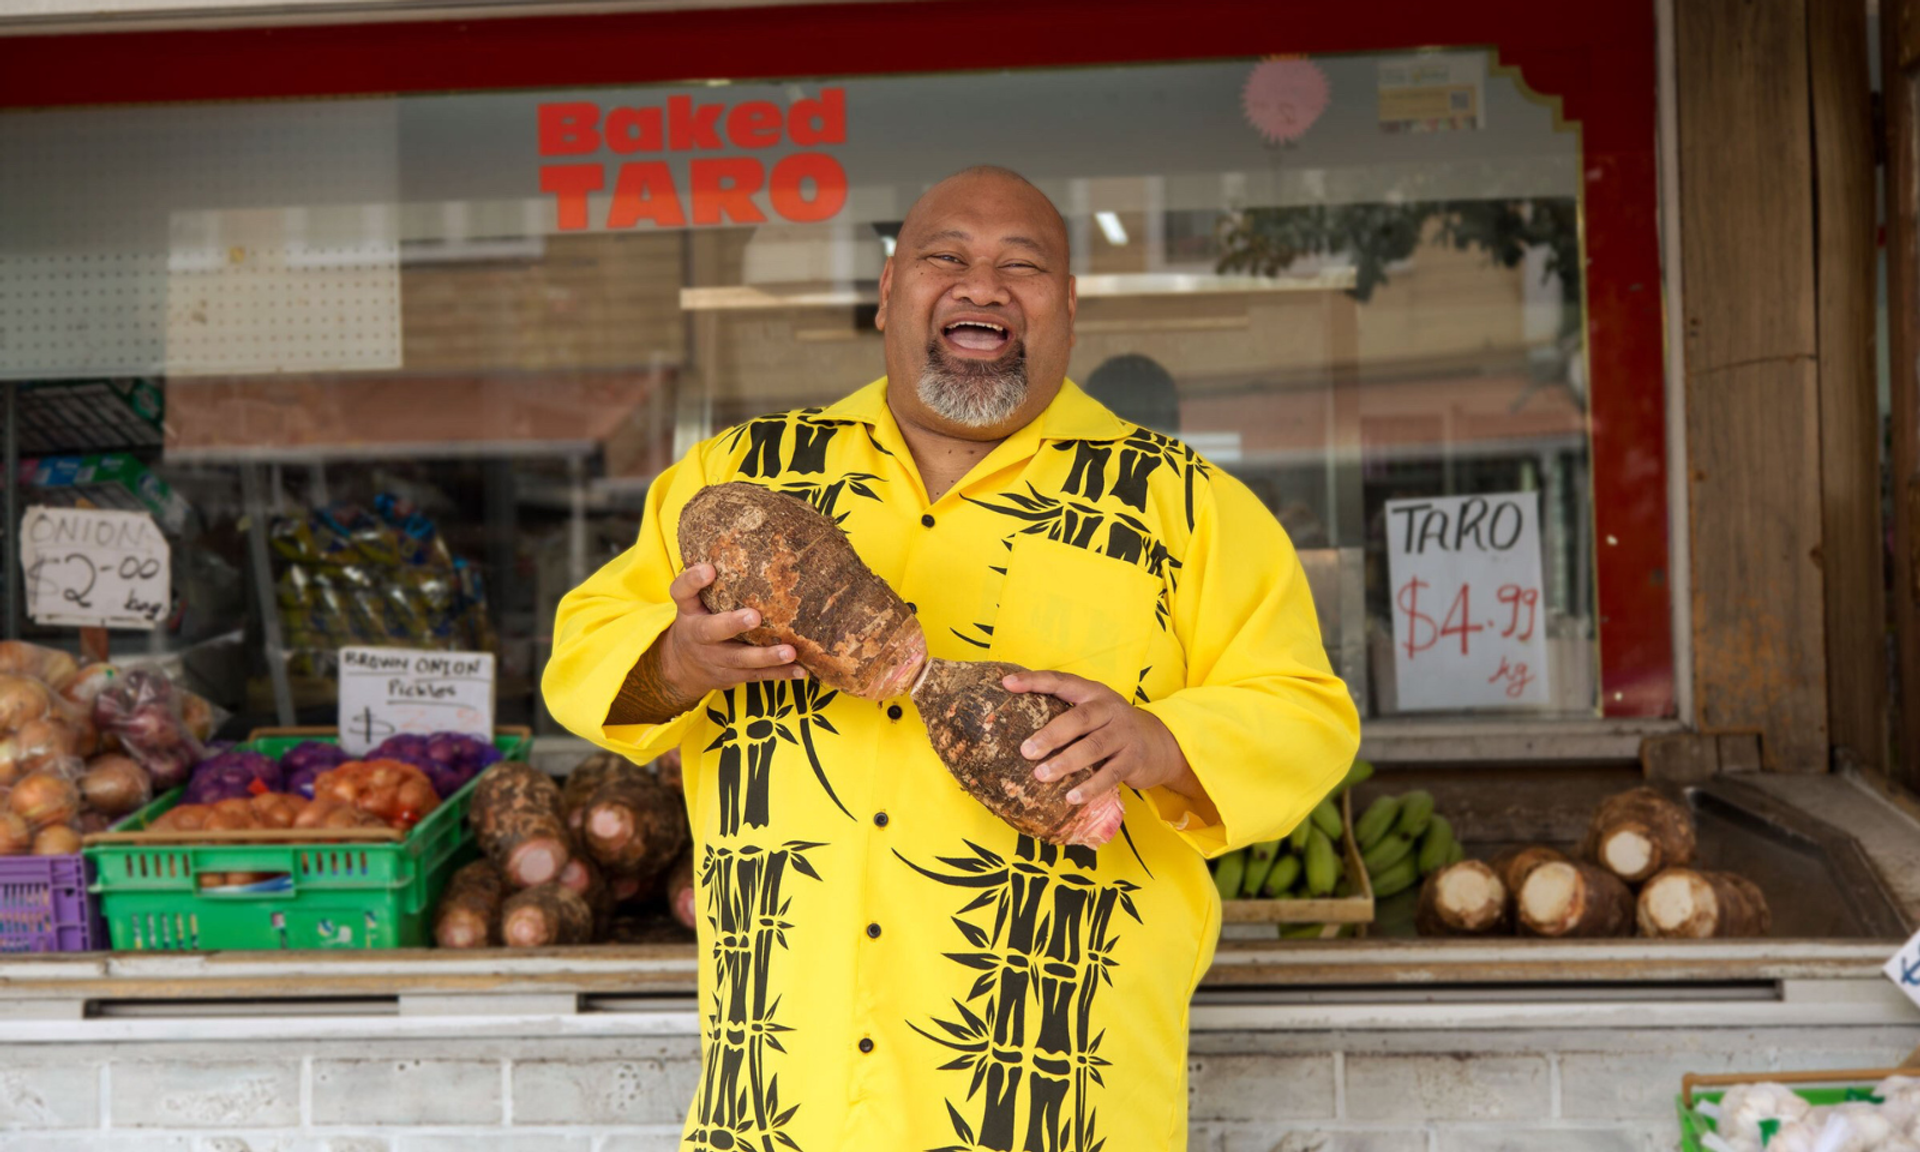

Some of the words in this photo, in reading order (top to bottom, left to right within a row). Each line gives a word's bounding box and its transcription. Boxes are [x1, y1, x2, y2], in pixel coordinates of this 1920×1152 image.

[537, 87, 847, 157] Baked
[539, 151, 848, 231] TARO
[1391, 497, 1523, 554] TARO
[1397, 575, 1539, 661] $4.99
[345, 651, 409, 670] BROWN
[415, 656, 482, 677] ONION
[1488, 656, 1537, 699] kg
